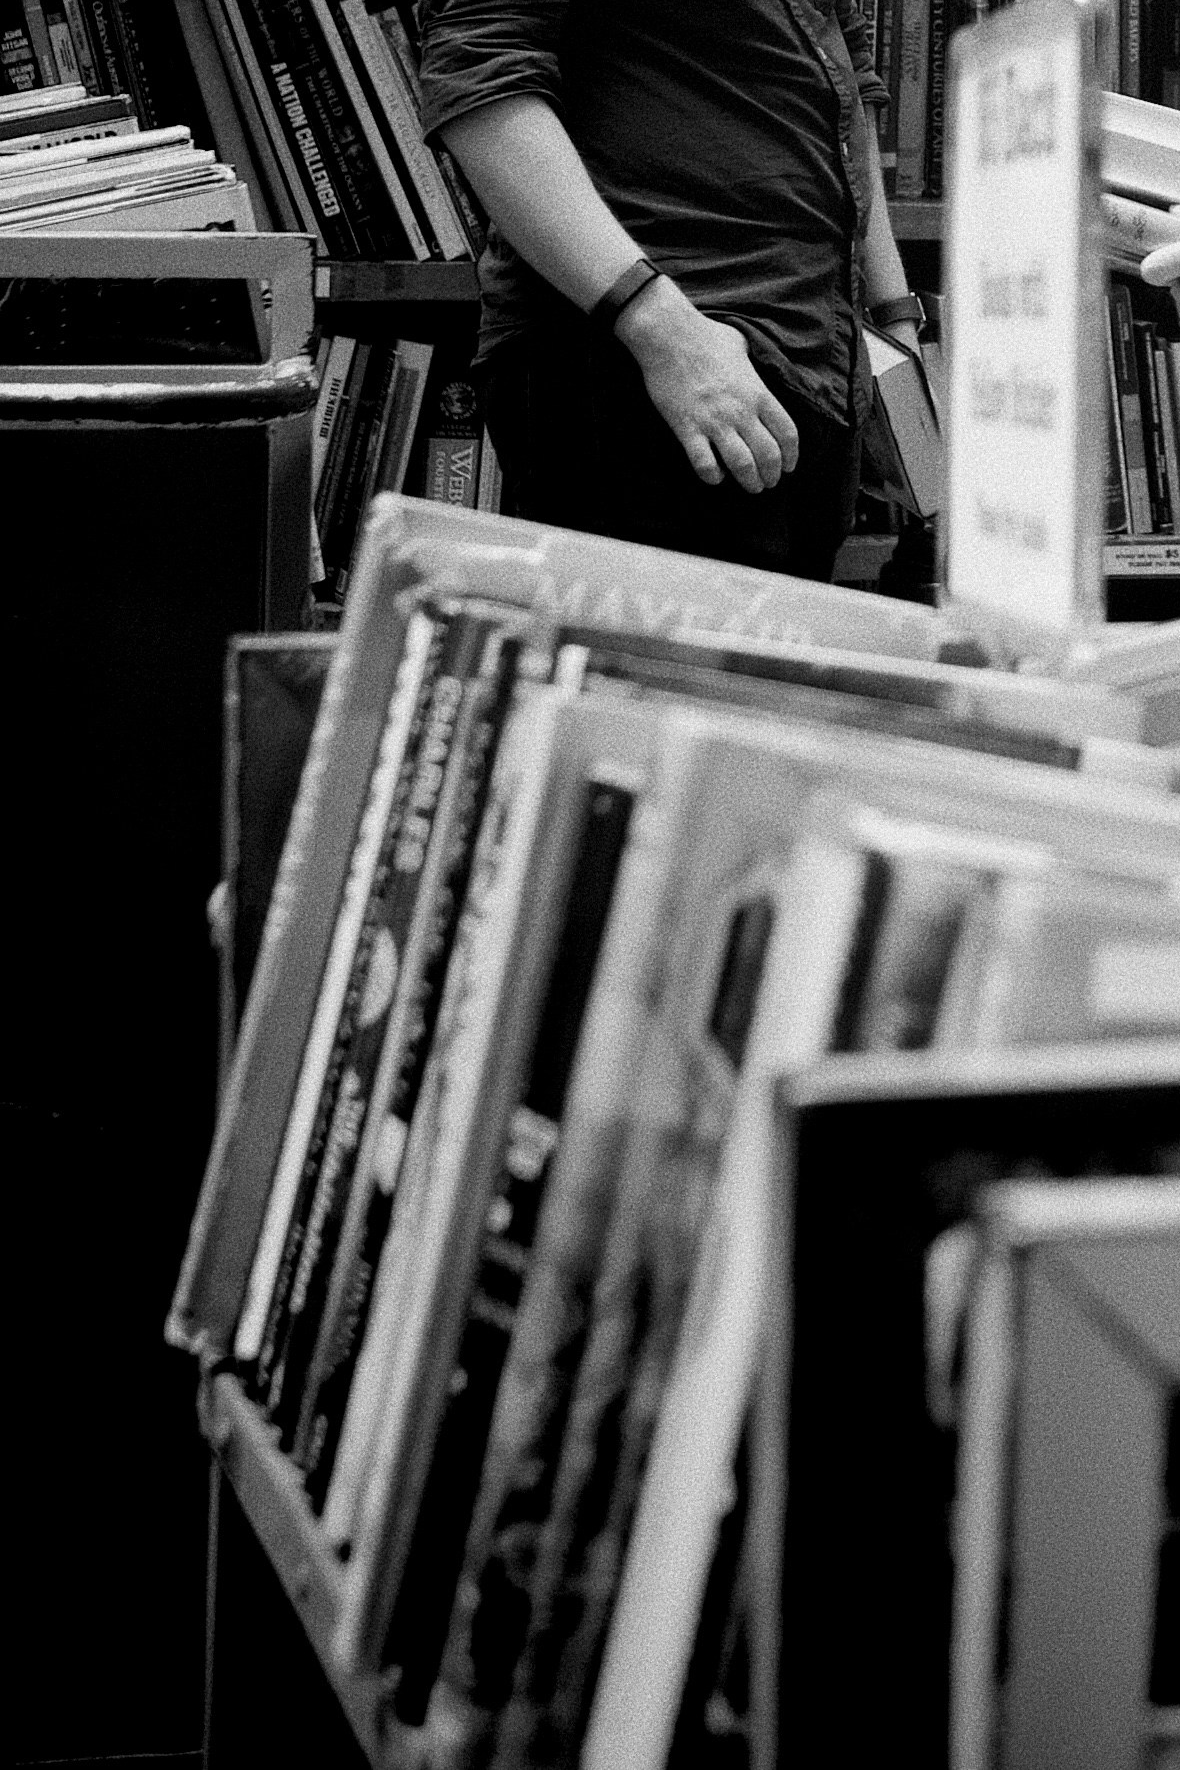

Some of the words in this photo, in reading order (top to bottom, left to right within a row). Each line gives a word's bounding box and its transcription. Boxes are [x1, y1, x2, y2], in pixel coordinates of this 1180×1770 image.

[268, 59, 288, 75] A
[304, 42, 321, 65] THE
[314, 66, 345, 118] WORLD
[930, 19, 943, 103] CENTURIES
[272, 71, 310, 129] NATION
[931, 107, 944, 126] OF
[931, 132, 944, 163] ART
[292, 126, 345, 218] CHALLENGED
[1163, 548, 1179, 559] $5
